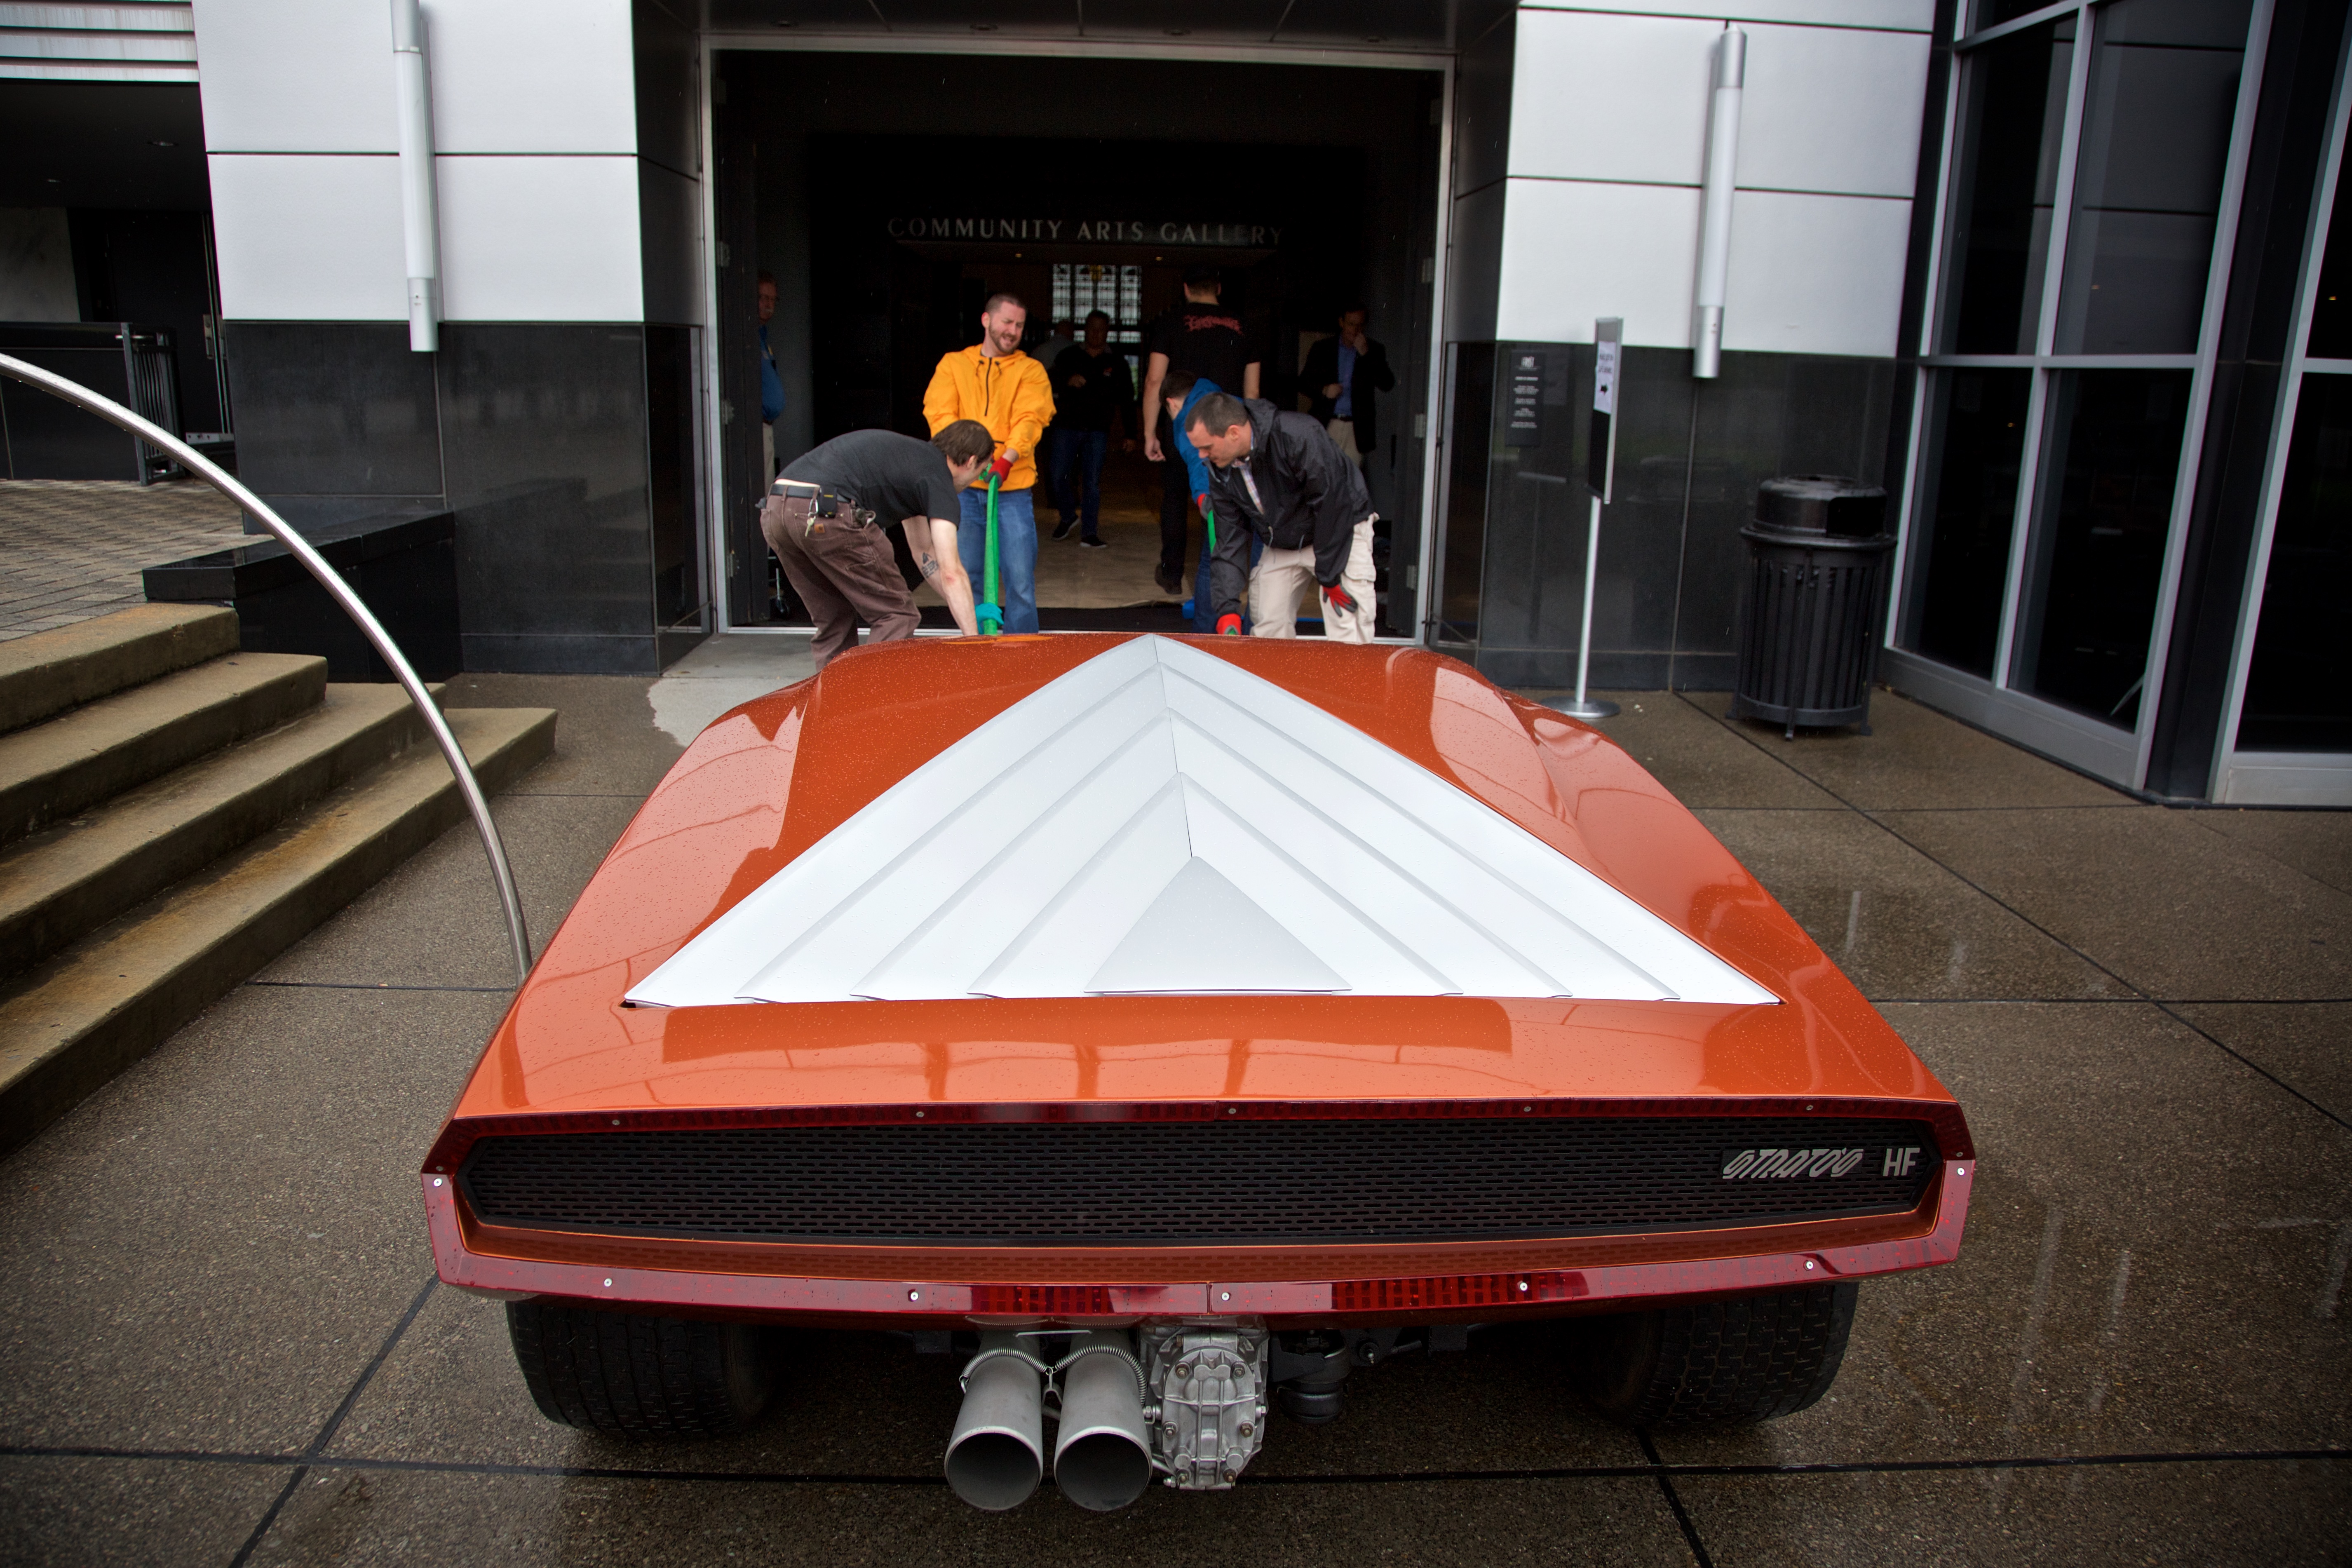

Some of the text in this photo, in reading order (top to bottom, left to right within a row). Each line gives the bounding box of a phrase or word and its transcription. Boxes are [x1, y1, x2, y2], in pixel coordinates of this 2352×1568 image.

[887, 217, 1284, 246] COMMUNITY ARTS GALLERY
[1882, 1147, 1920, 1177] HF
